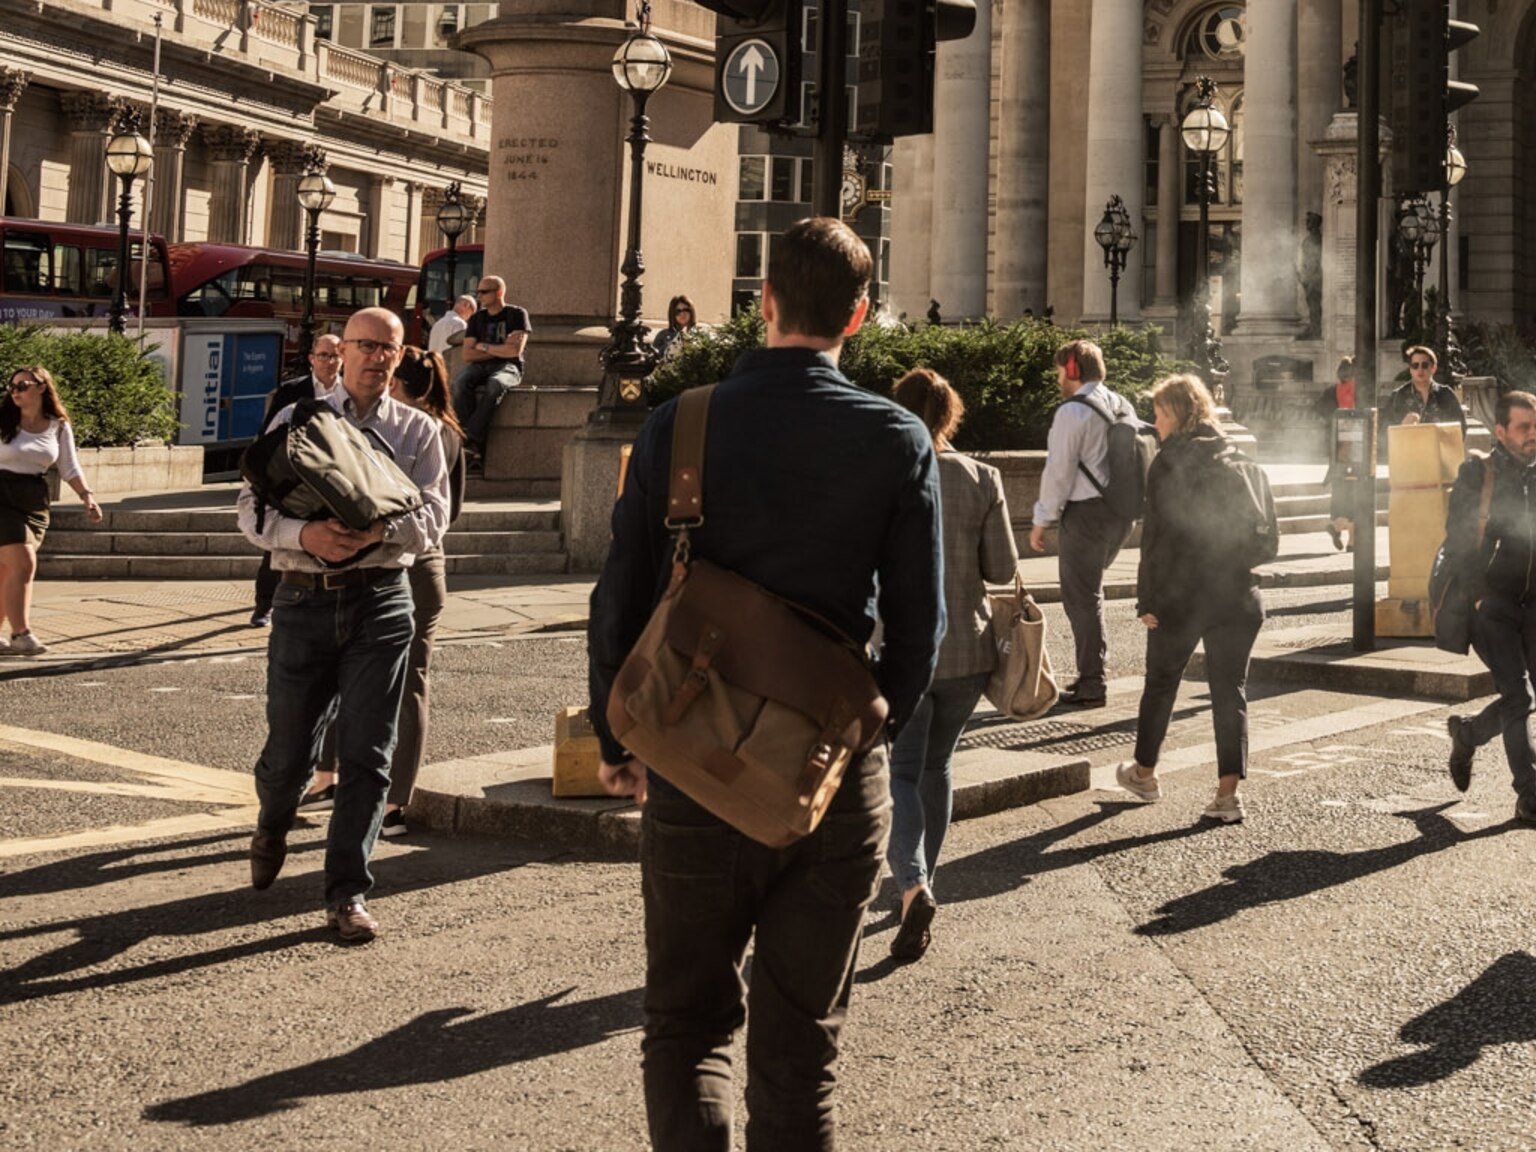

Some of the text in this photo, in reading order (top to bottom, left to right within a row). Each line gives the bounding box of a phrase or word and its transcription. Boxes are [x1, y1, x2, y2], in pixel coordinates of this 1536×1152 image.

[498, 138, 559, 149] ERECTED
[503, 154, 534, 164] JUNE
[646, 160, 717, 185] WELLINGTON
[4, 309, 15, 318] TO
[17, 309, 37, 319] YOUR
[202, 342, 220, 436] Initial
